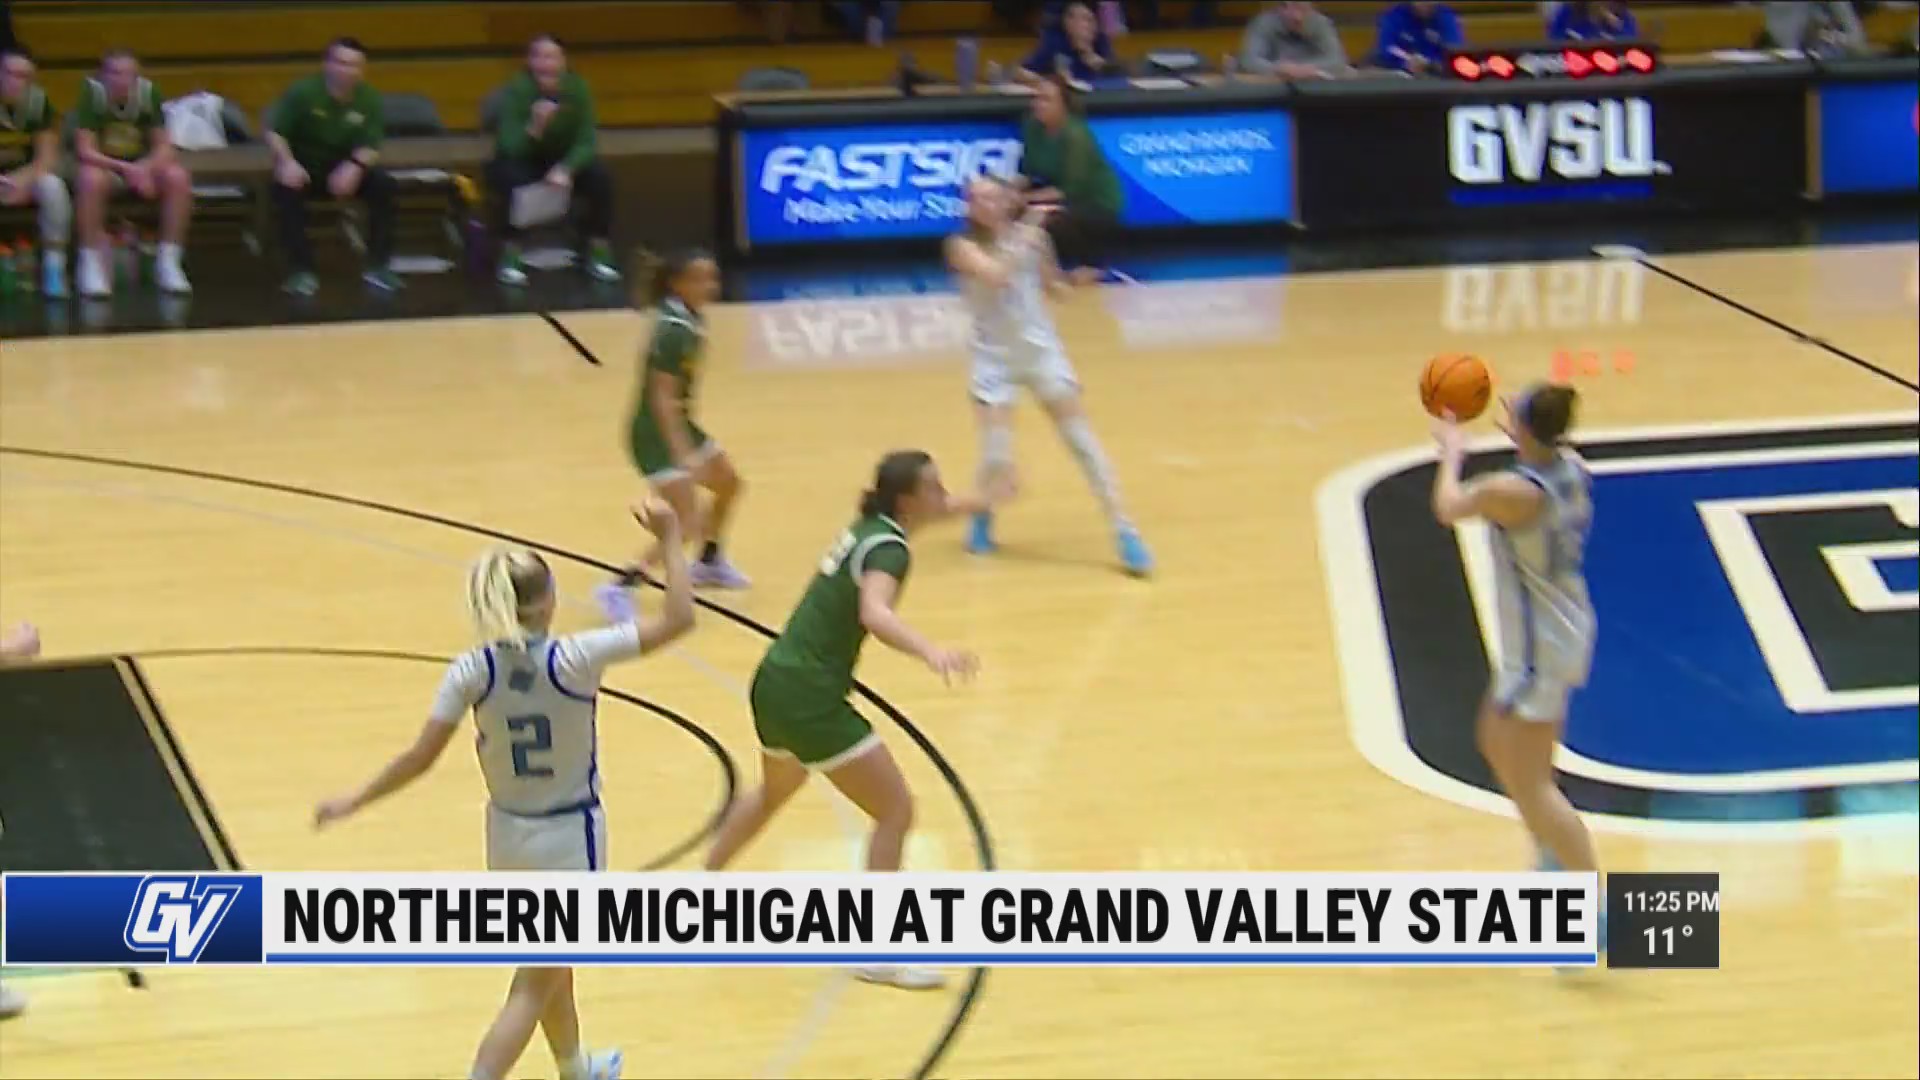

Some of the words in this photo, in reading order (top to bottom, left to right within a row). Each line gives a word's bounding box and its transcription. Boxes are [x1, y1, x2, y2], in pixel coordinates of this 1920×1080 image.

[760, 139, 1024, 193] FASTSIG
[1449, 98, 1654, 183] GVSU
[508, 715, 553, 777] 2
